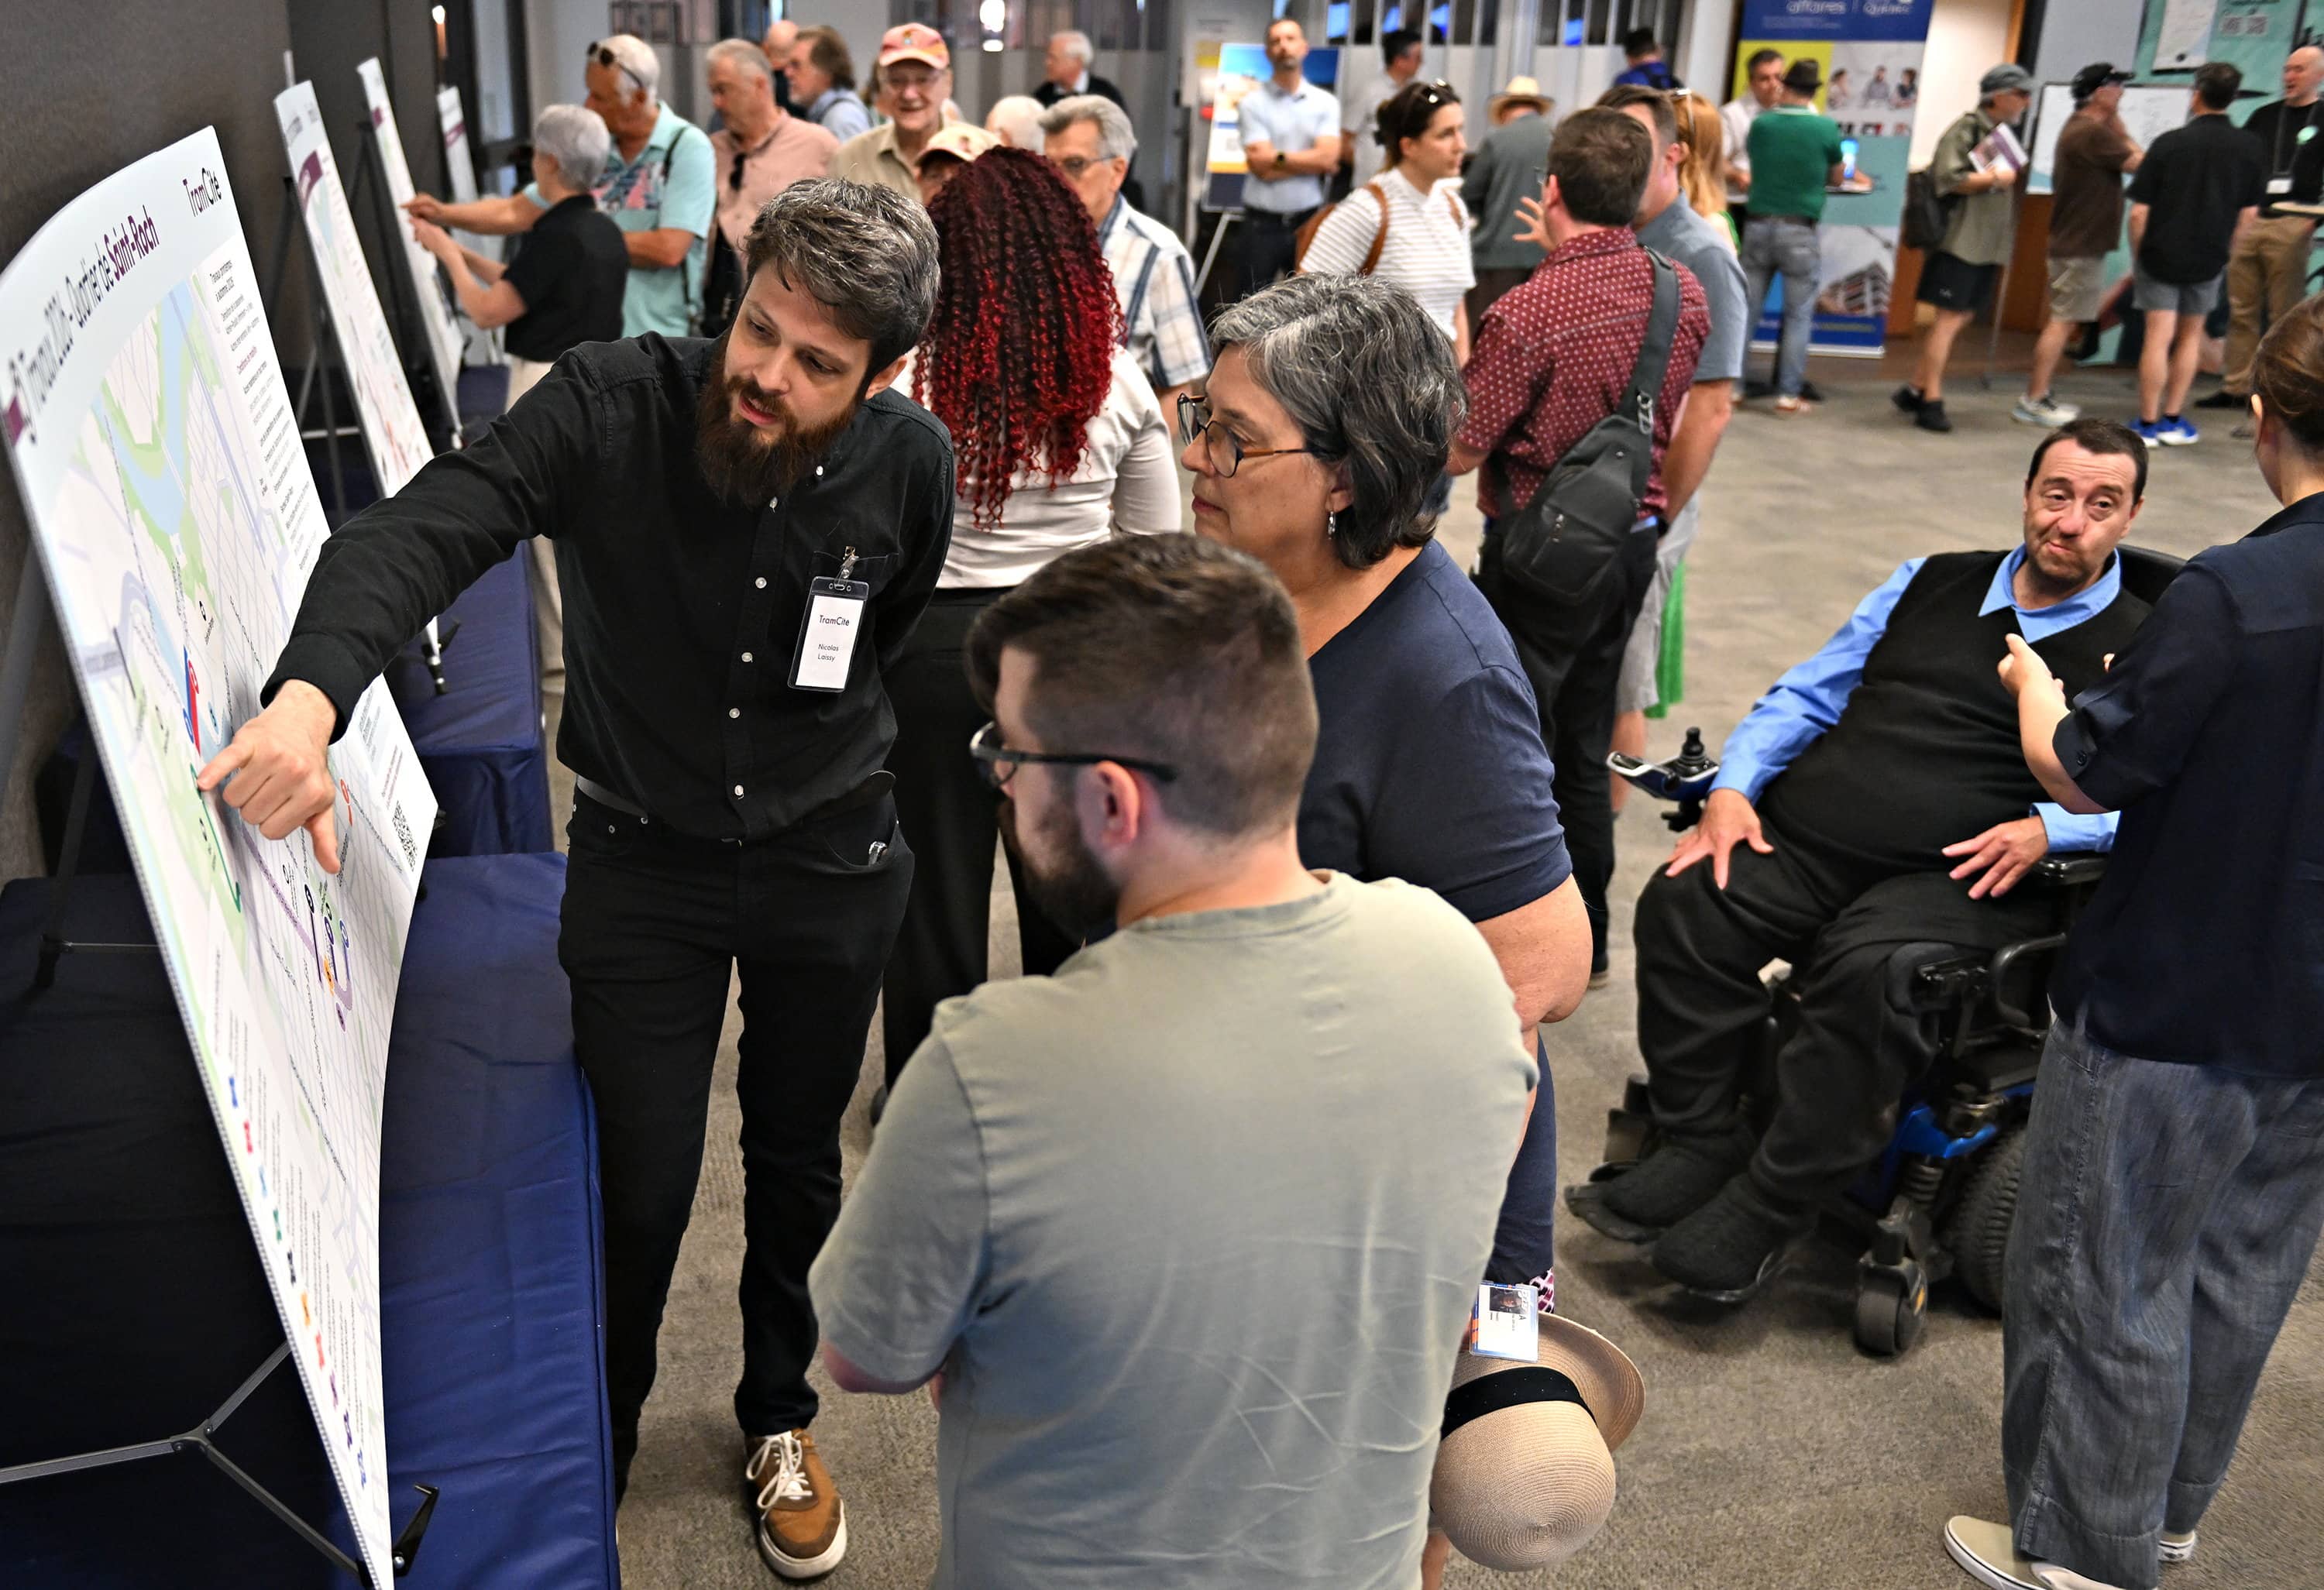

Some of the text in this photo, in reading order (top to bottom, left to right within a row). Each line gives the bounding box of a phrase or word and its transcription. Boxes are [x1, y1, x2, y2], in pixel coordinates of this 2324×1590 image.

[95, 242, 114, 292] de
[104, 204, 160, 281] Saint-Roch
[66, 258, 104, 328] Quartier
